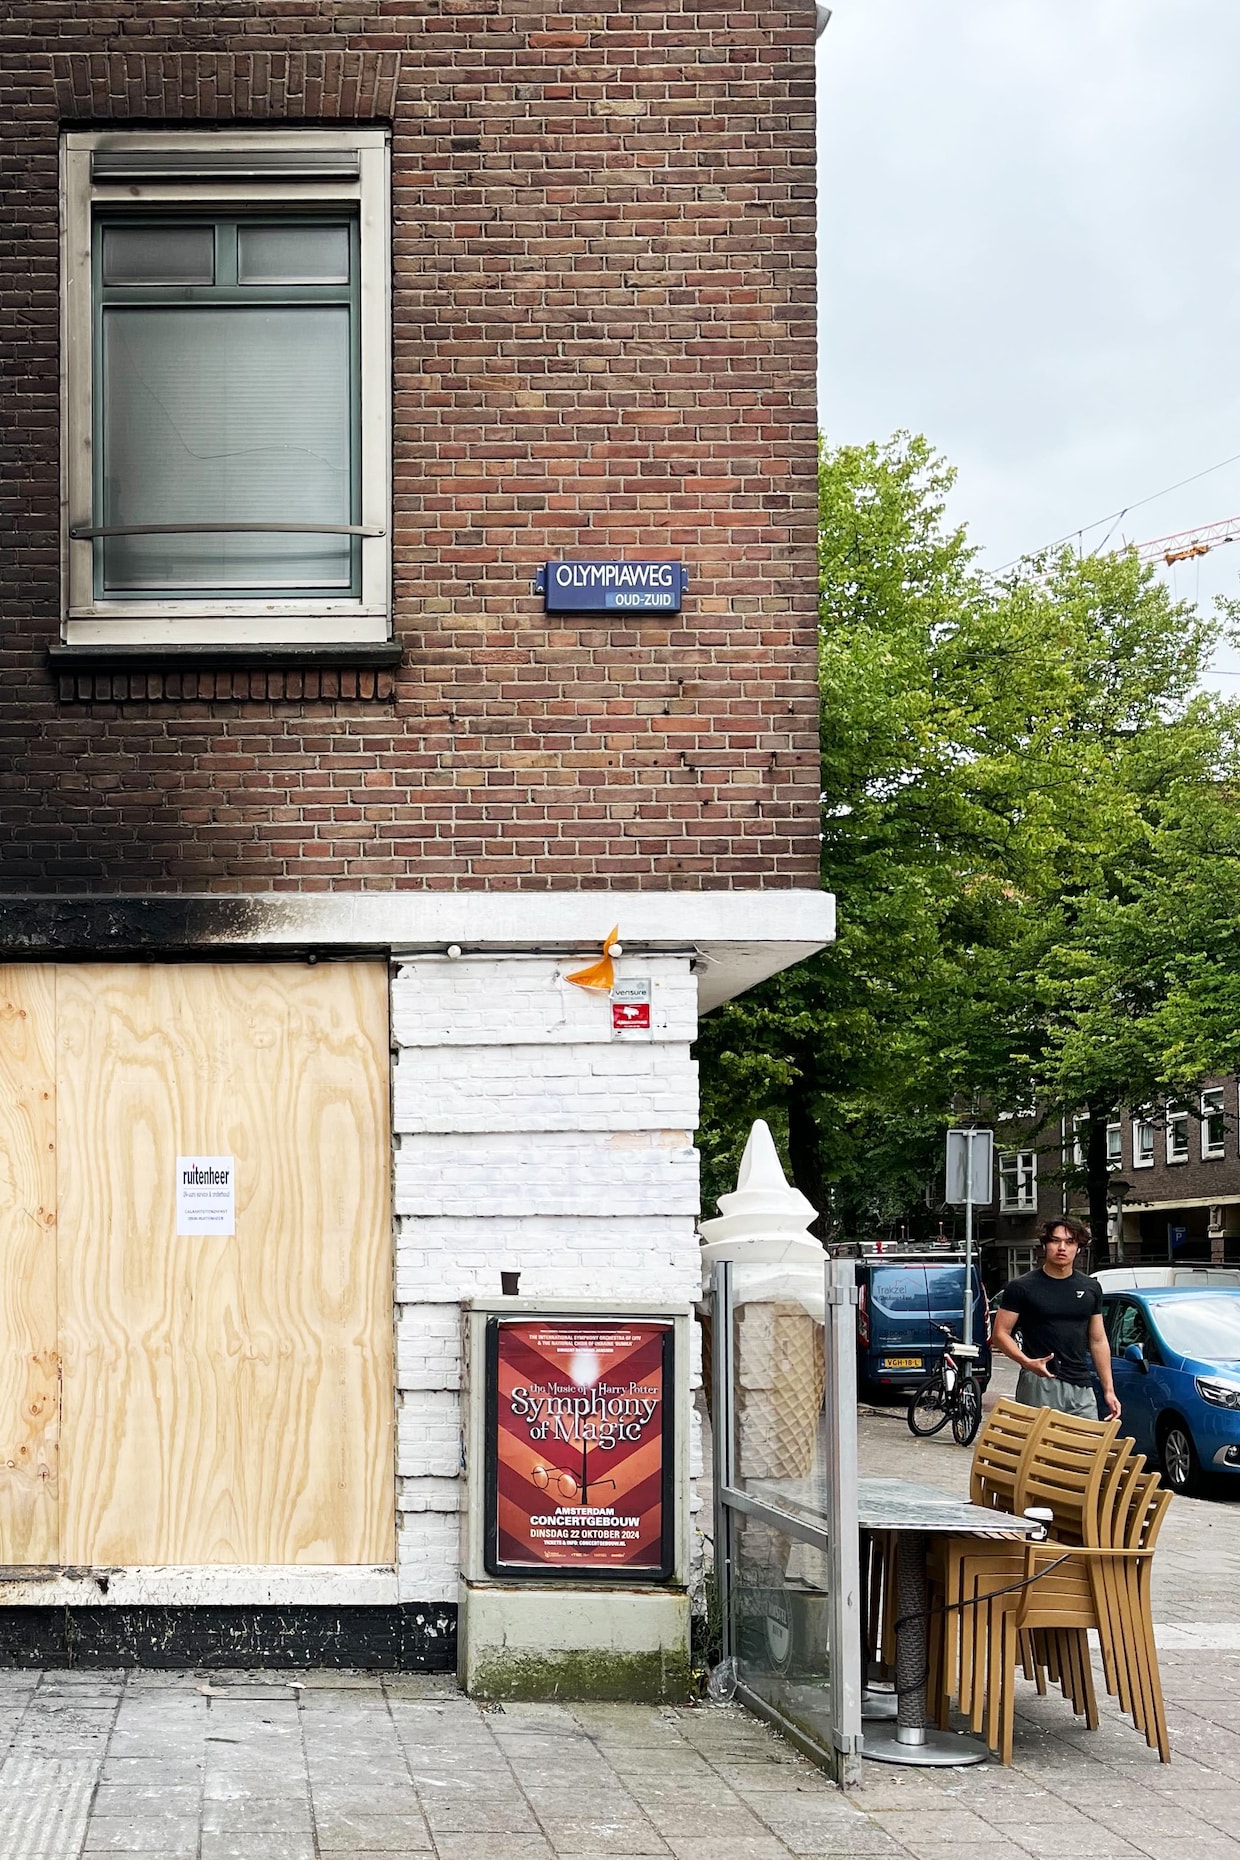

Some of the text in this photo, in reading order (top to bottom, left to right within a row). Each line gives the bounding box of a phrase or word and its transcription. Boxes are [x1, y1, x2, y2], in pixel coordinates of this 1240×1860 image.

[556, 565, 672, 587] OLYMPIAWEG
[615, 594, 671, 606] OUD-ZUID
[183, 1162, 230, 1185] ruitenheer
[1175, 1232, 1183, 1241] P
[876, 1285, 907, 1295] Trakzel
[547, 1382, 576, 1394] Music
[577, 1382, 589, 1395] of
[598, 1382, 628, 1396] Harry
[629, 1381, 659, 1395] Potter
[511, 1386, 660, 1424] Symphony
[529, 1415, 642, 1450] of Magic
[555, 1507, 615, 1516] AMSTERDAM
[529, 1515, 640, 1527] CONCERTGEBOUW
[529, 1529, 640, 1540] DINSDAG 22 OKTOBER 2024
